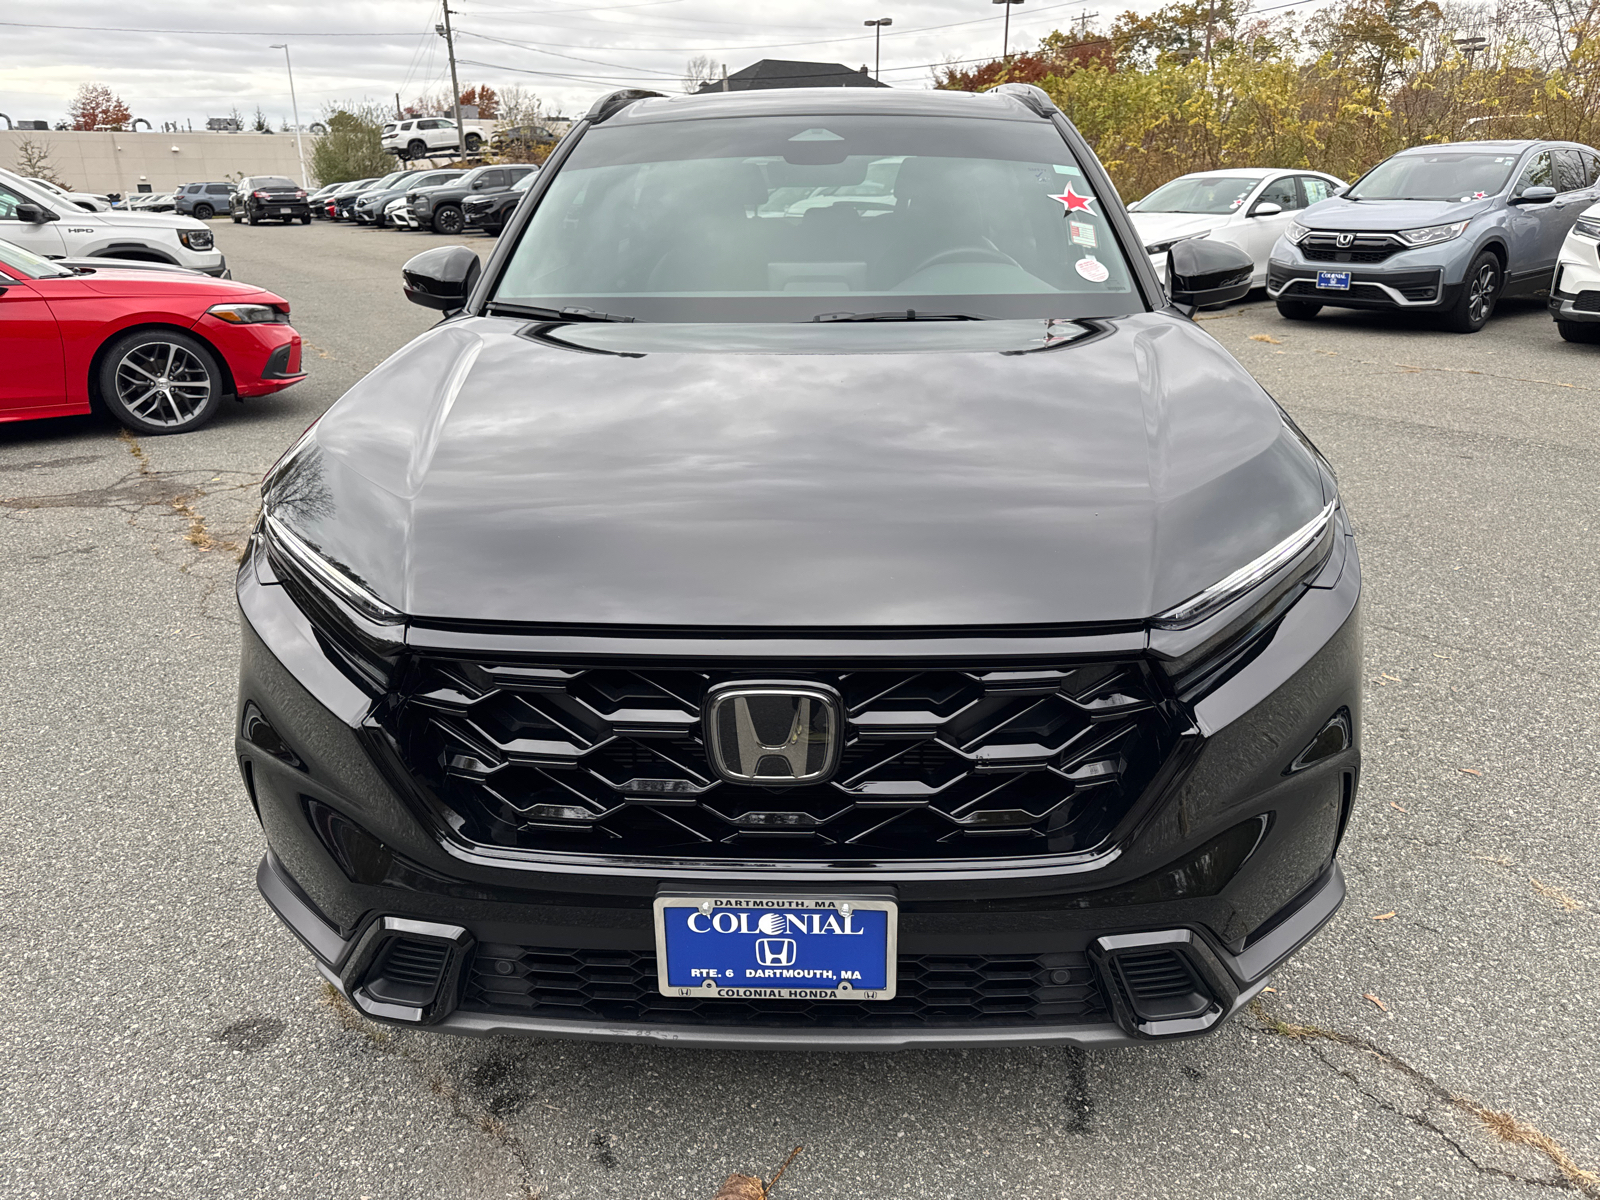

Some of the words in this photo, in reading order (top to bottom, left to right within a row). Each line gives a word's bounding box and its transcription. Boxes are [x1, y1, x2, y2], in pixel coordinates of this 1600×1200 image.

[687, 912, 864, 935] COLONIAL
[691, 968, 722, 978] RTE.
[725, 968, 735, 978] 6
[745, 969, 837, 981] DARTMOUTH,
[840, 970, 862, 980] MA
[717, 988, 784, 998] COLONIAL
[788, 990, 838, 999] HONDA
